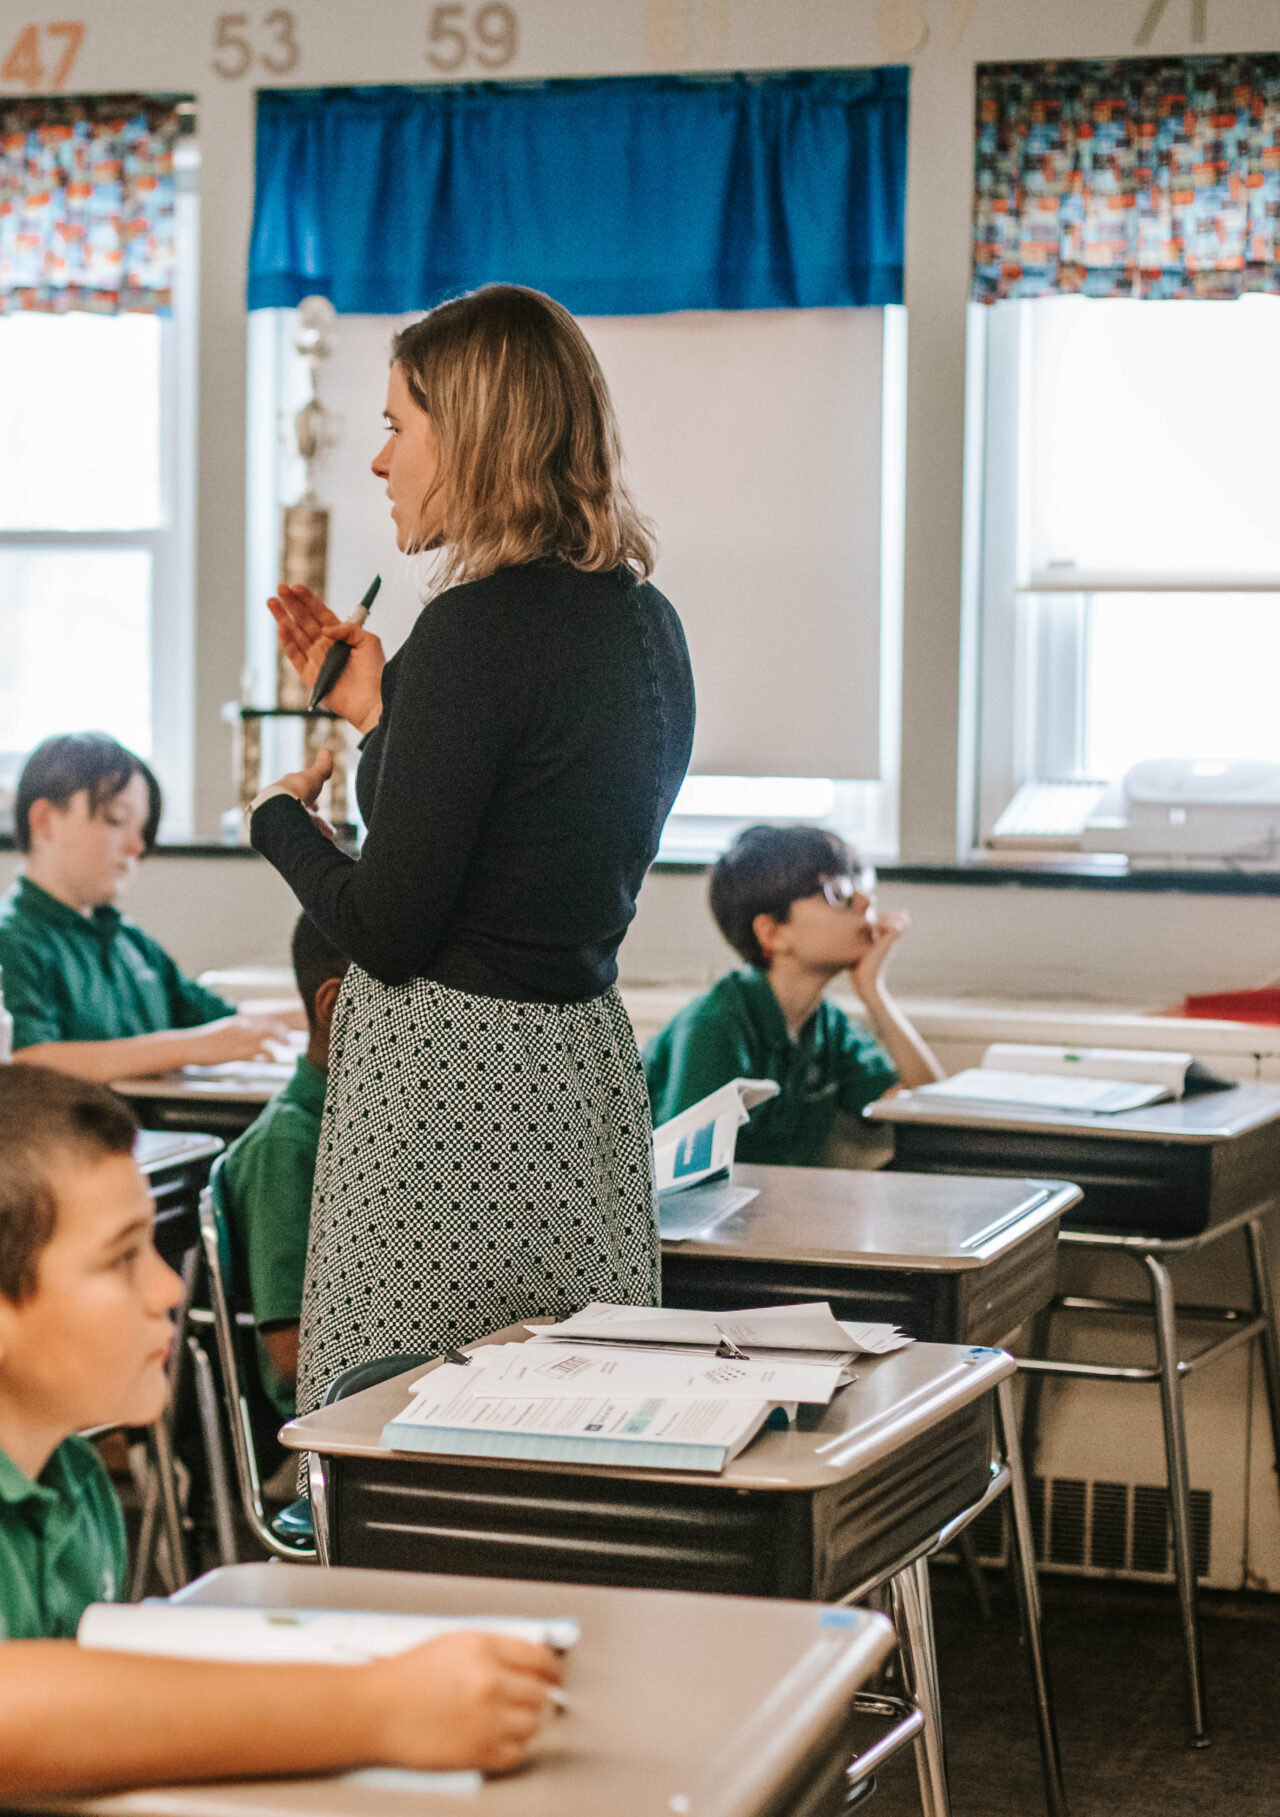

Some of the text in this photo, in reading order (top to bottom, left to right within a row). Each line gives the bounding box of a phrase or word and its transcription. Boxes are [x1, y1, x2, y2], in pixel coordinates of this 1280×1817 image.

[0, 20, 87, 92] 47
[211, 8, 301, 80] 53
[426, 1, 519, 72] 59
